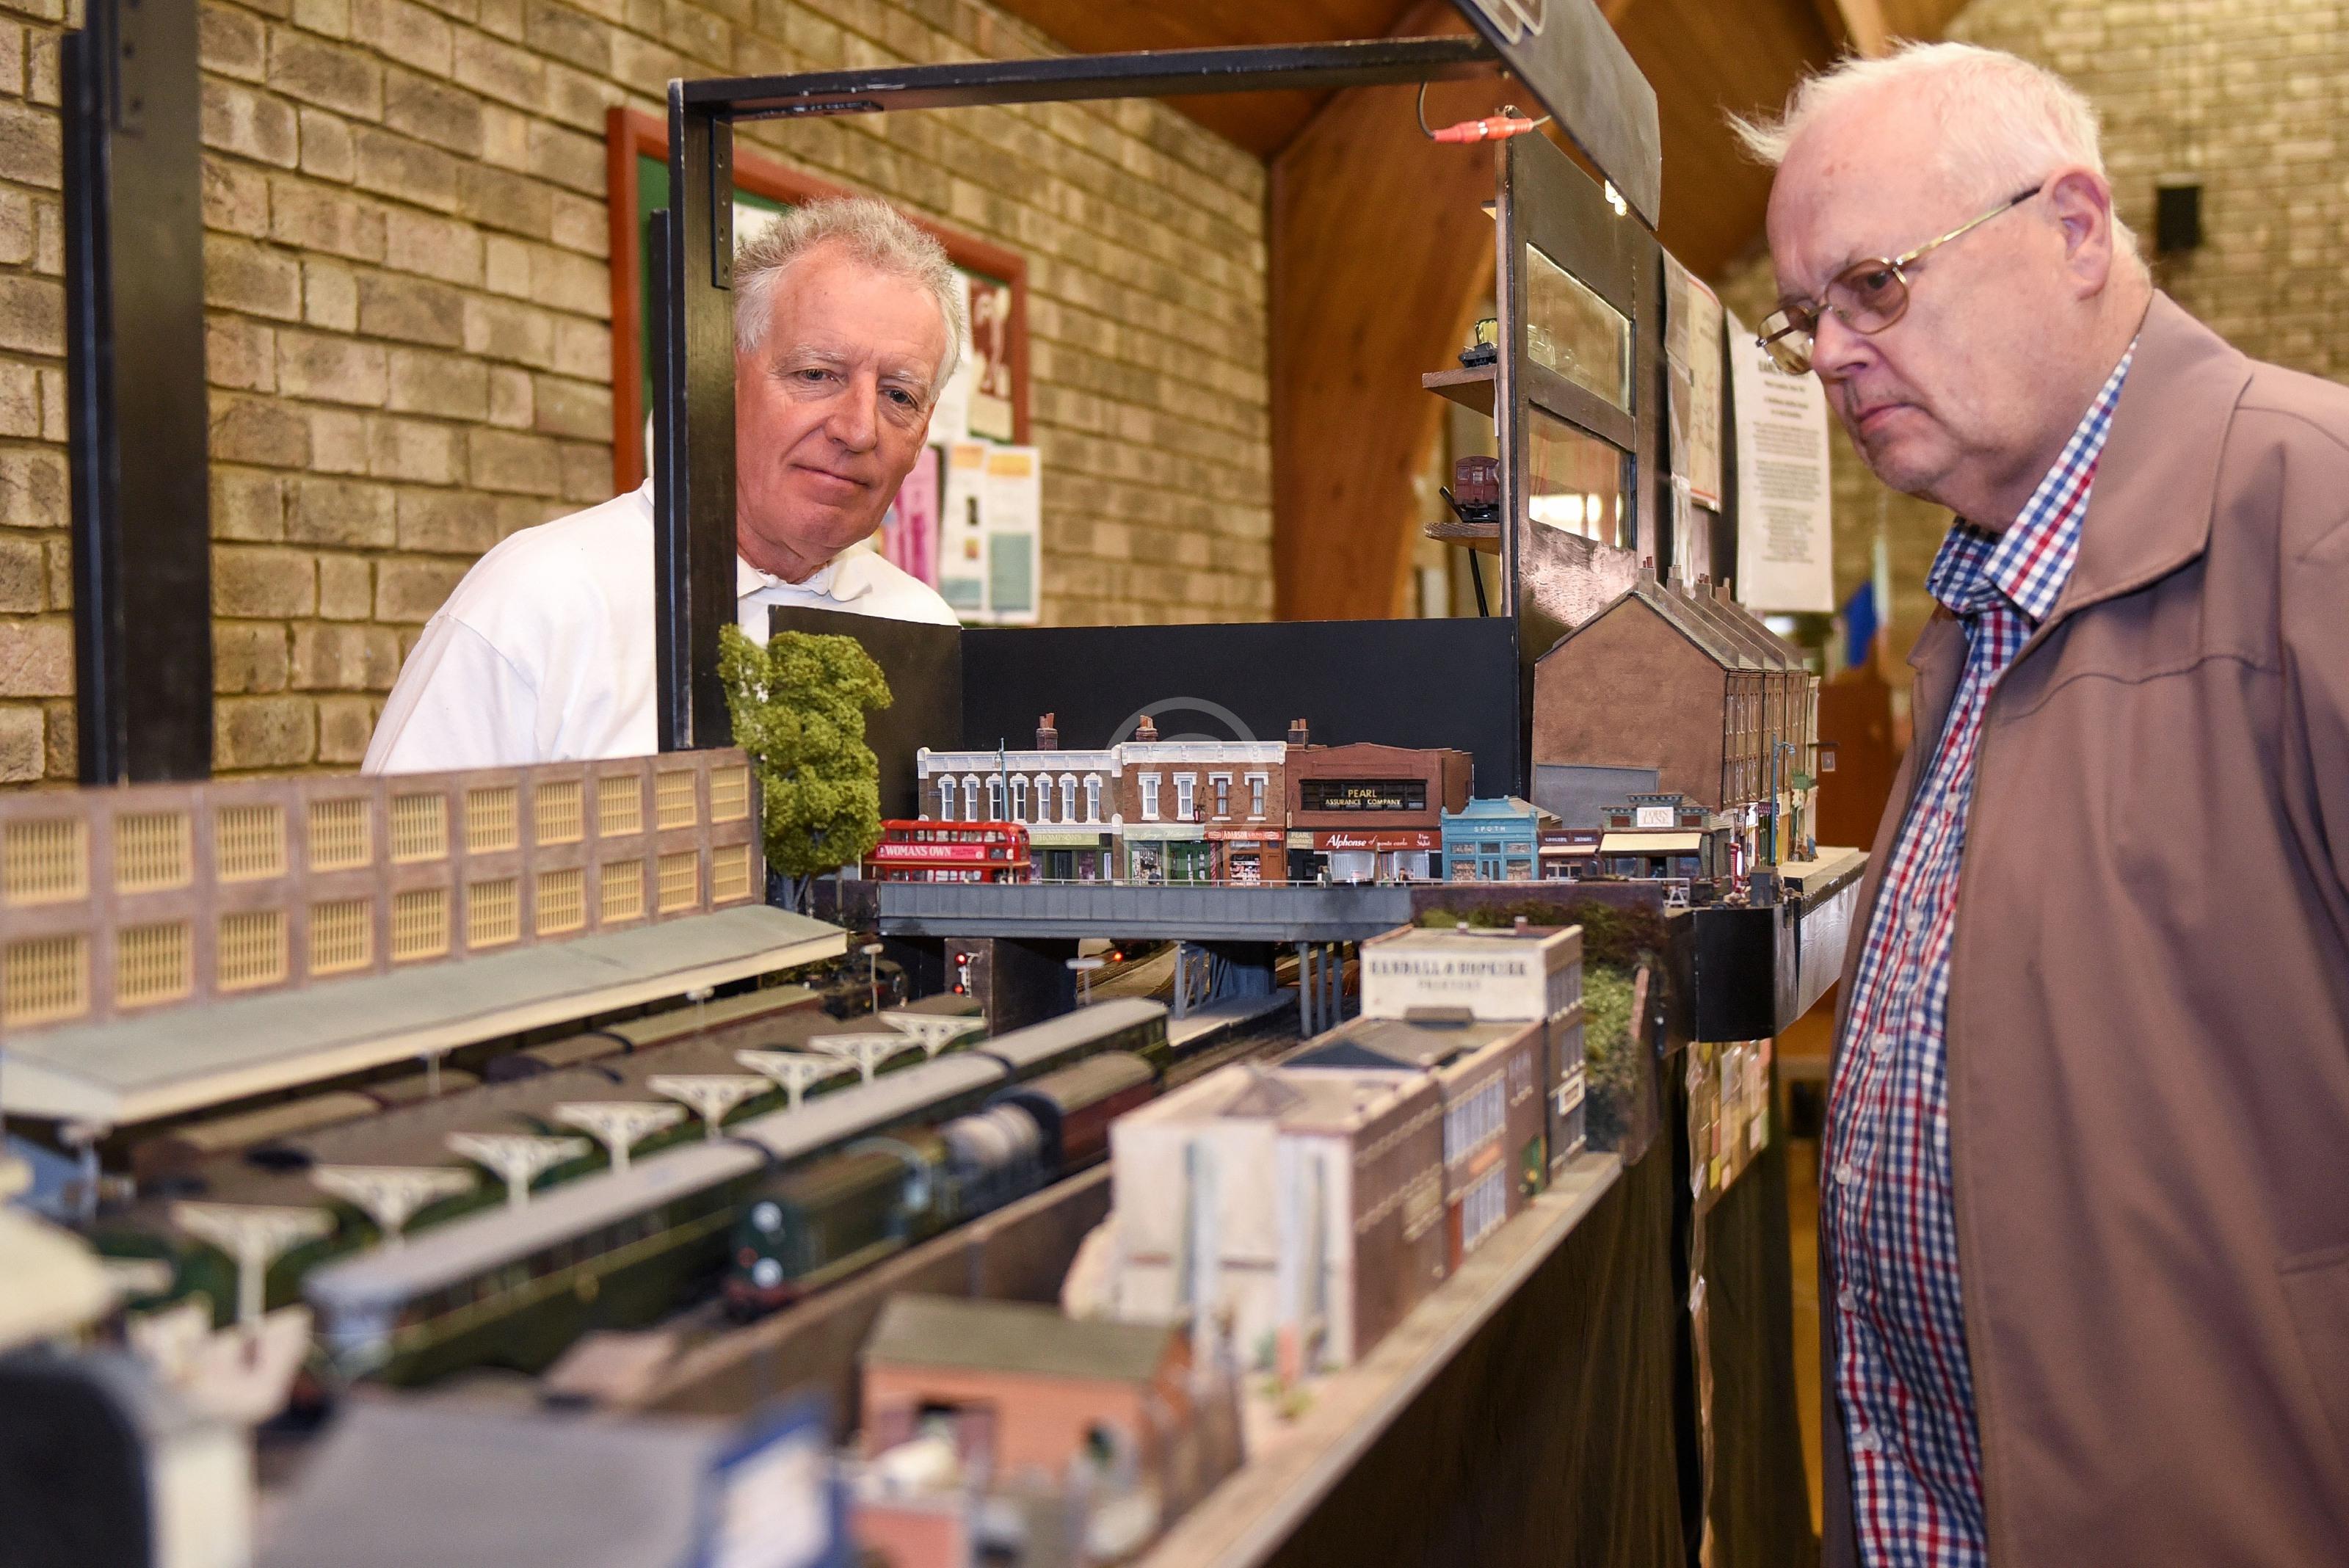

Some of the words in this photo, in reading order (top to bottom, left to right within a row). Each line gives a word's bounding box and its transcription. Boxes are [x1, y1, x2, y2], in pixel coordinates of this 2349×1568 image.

[1348, 789, 1377, 798] PEARL
[1326, 834, 1367, 849] Alphonse
[929, 846, 951, 857] OWN
